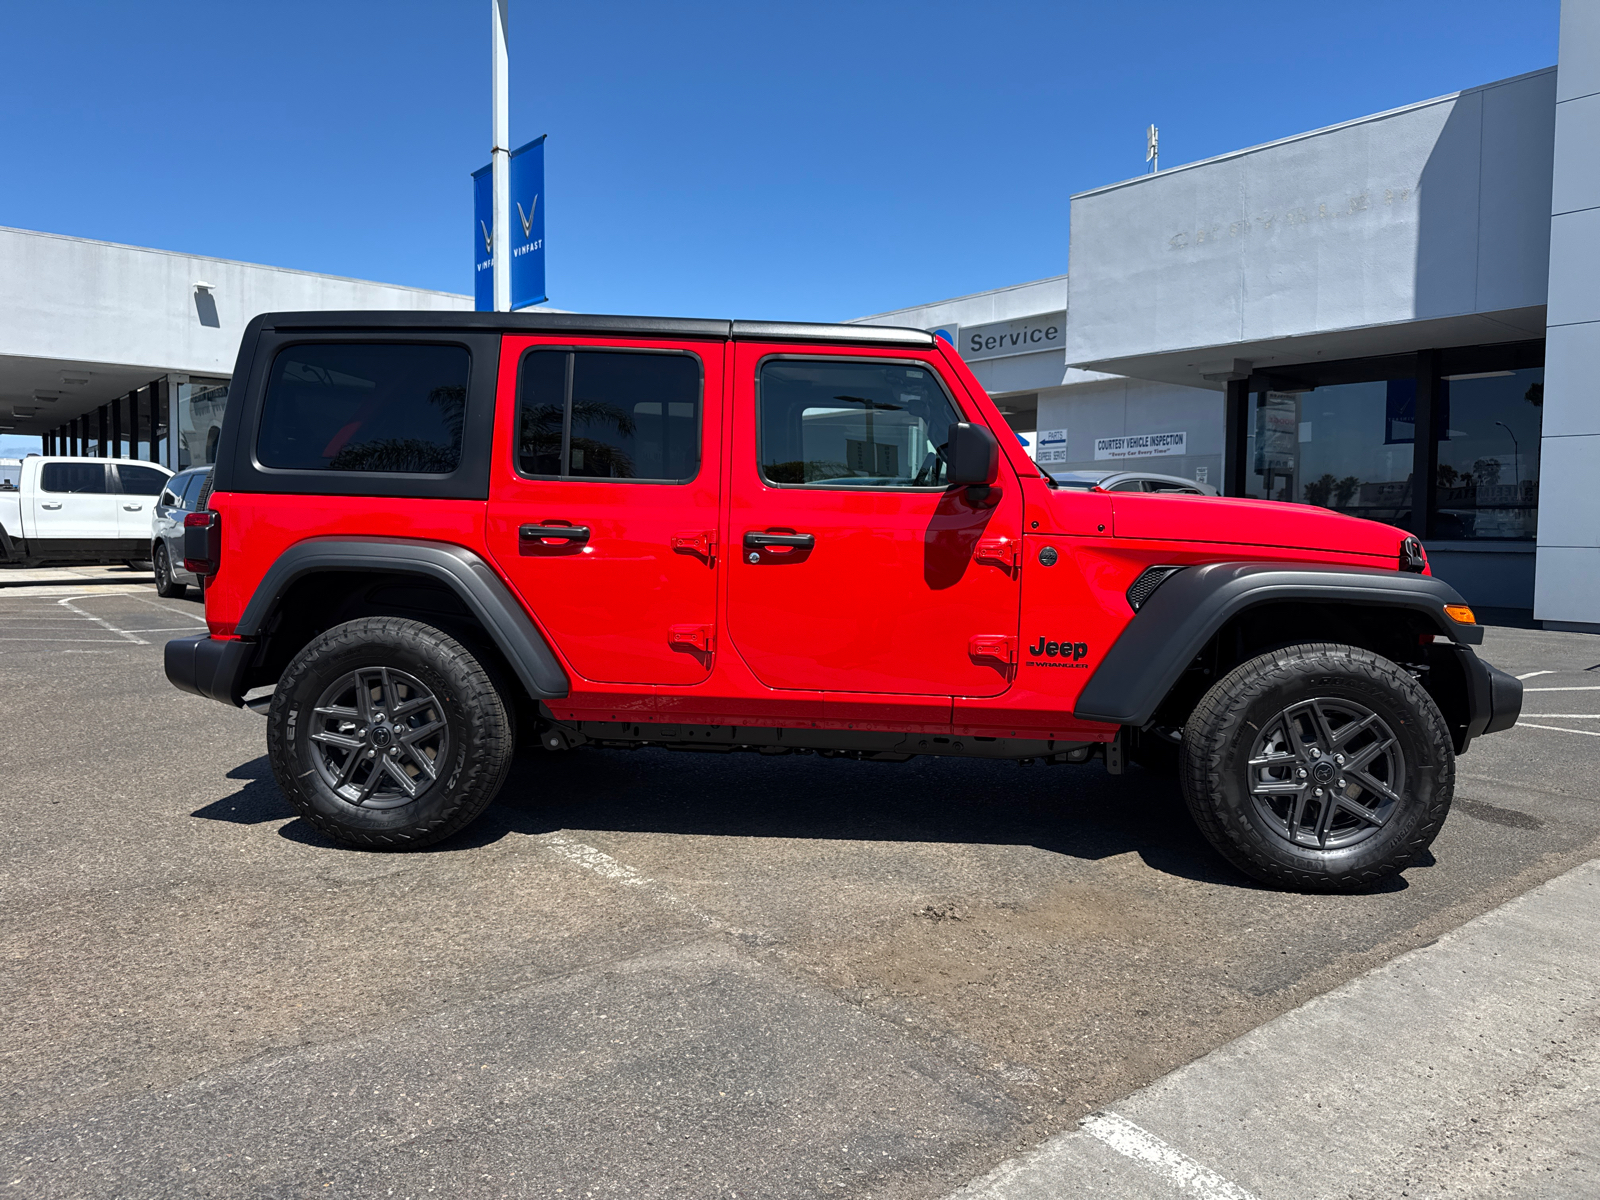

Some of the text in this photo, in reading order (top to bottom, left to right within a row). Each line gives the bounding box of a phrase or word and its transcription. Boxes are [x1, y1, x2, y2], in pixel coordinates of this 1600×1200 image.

[513, 239, 543, 258] VINFAST
[477, 258, 494, 272] VINFA
[970, 326, 1058, 352] Service
[1048, 431, 1063, 440] PARTS
[1098, 433, 1184, 451] COURTESY VEHICLE INSPECTION
[1029, 635, 1088, 662] Jeep
[1035, 661, 1089, 669] WRANGLER
